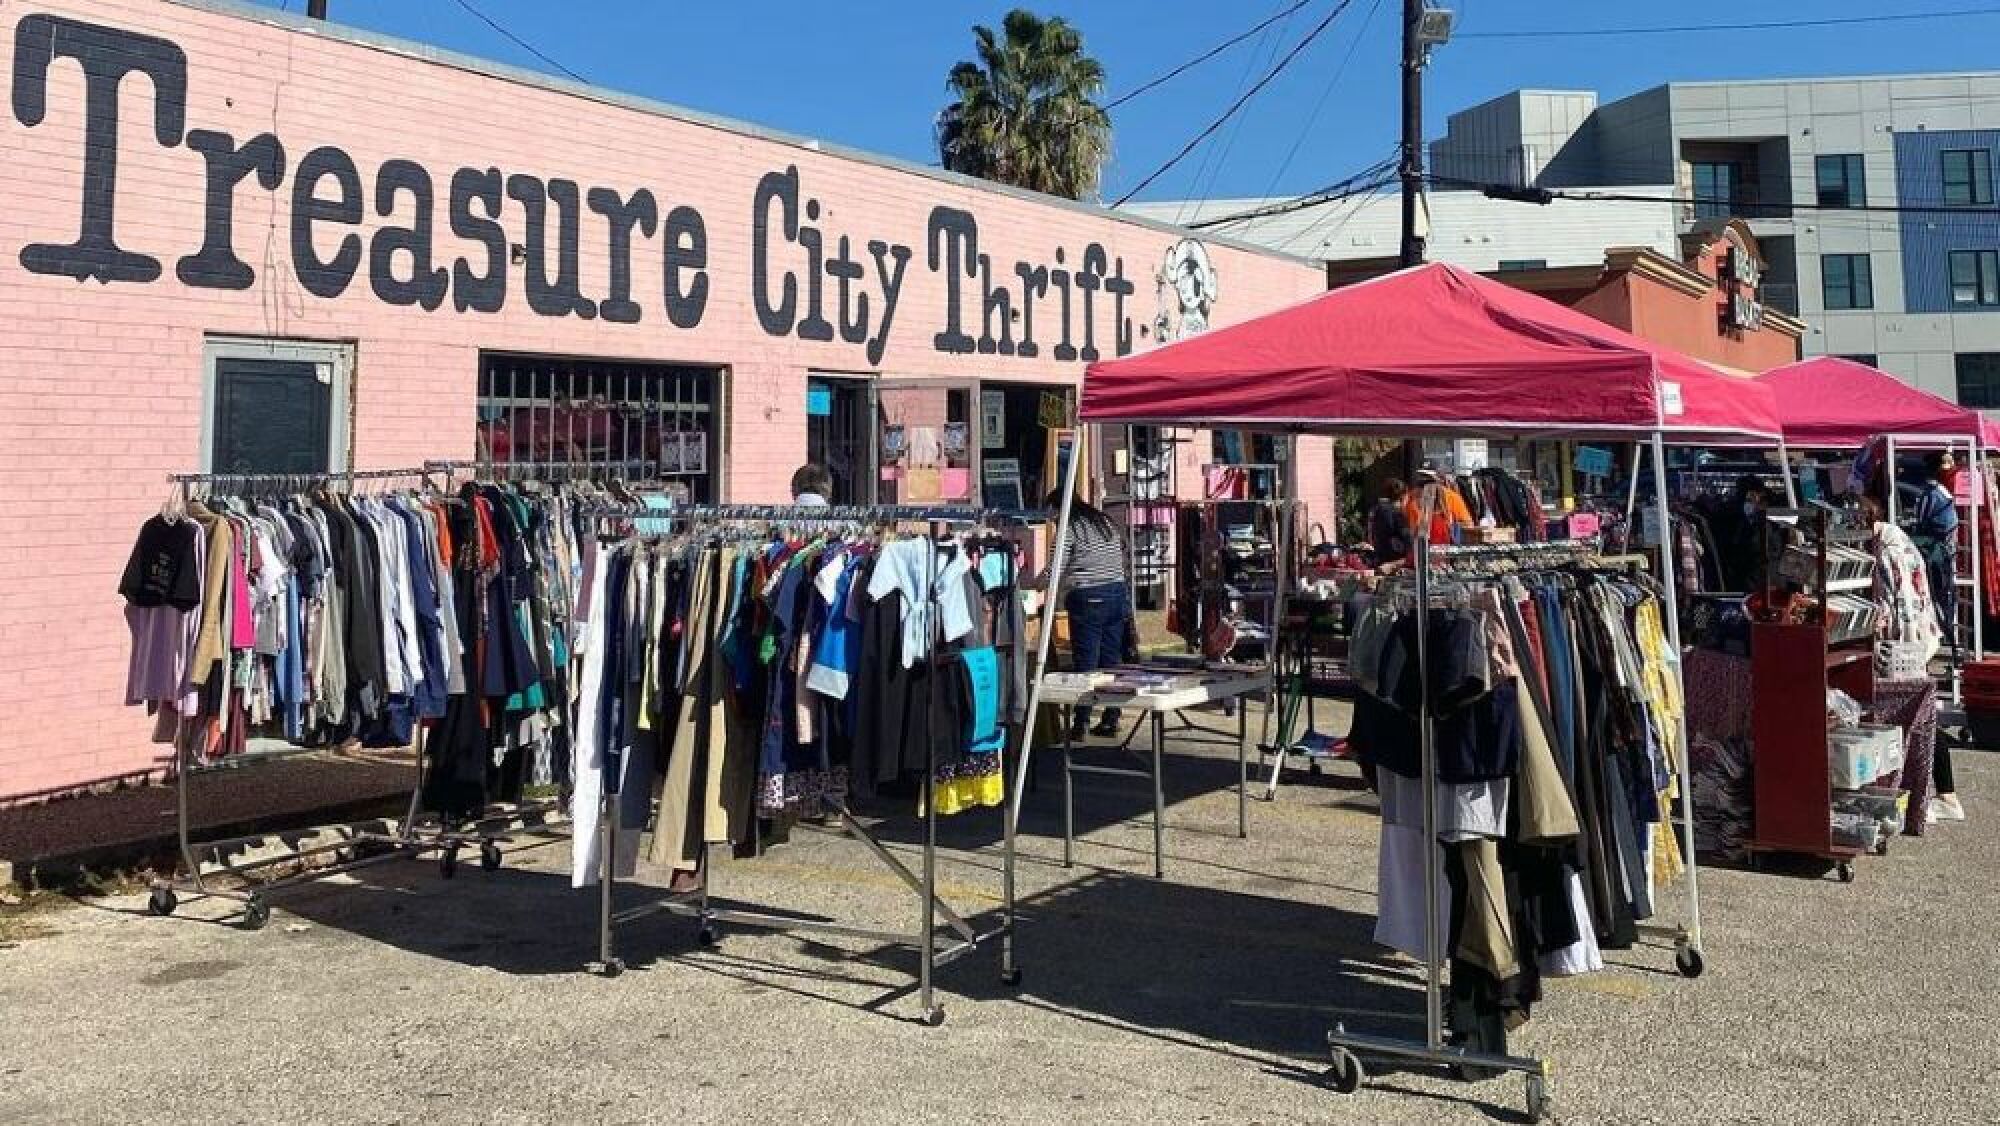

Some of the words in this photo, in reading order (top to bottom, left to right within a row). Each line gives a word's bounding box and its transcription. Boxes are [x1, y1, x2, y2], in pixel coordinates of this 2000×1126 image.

[13, 13, 708, 328] Treasure
[753, 164, 912, 366] City
[928, 206, 1134, 361] Thrift
